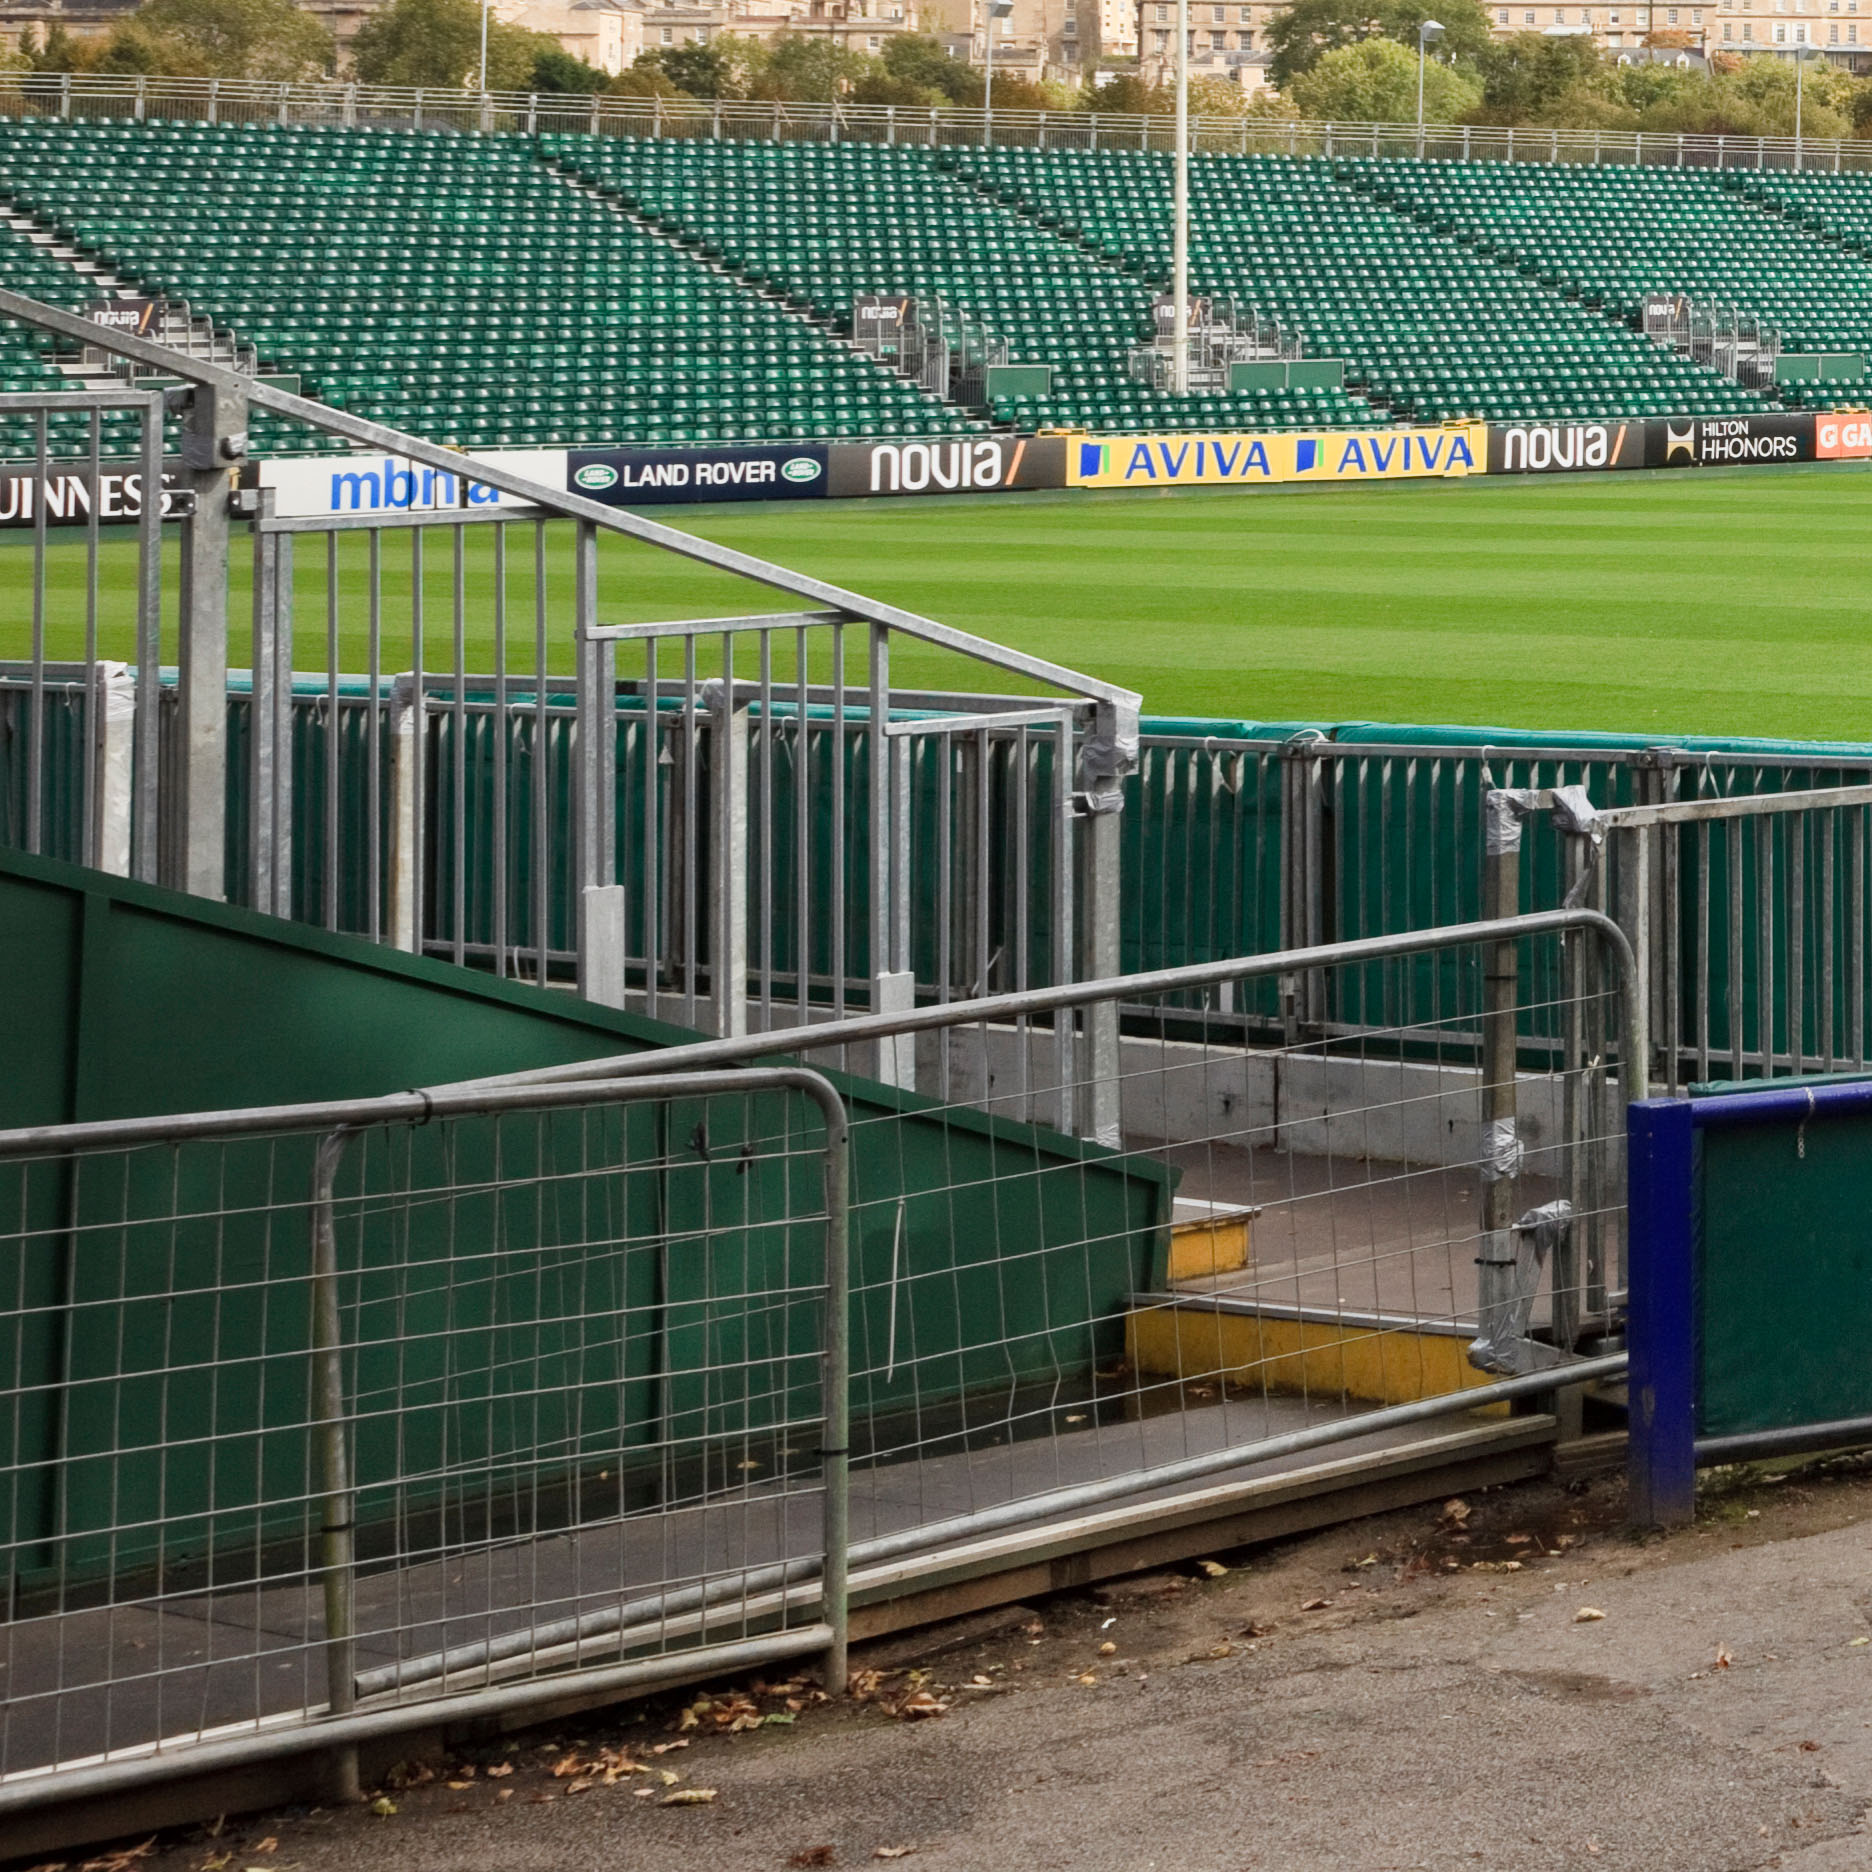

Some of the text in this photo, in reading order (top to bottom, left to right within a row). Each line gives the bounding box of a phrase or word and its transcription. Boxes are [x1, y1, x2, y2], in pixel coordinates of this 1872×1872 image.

[1702, 420, 1748, 437] HILTON
[1125, 441, 1271, 479] AVIVA
[1337, 434, 1475, 473] AVIVA
[1701, 435, 1797, 460] HHONORS
[623, 461, 776, 487] LAND ROVER
